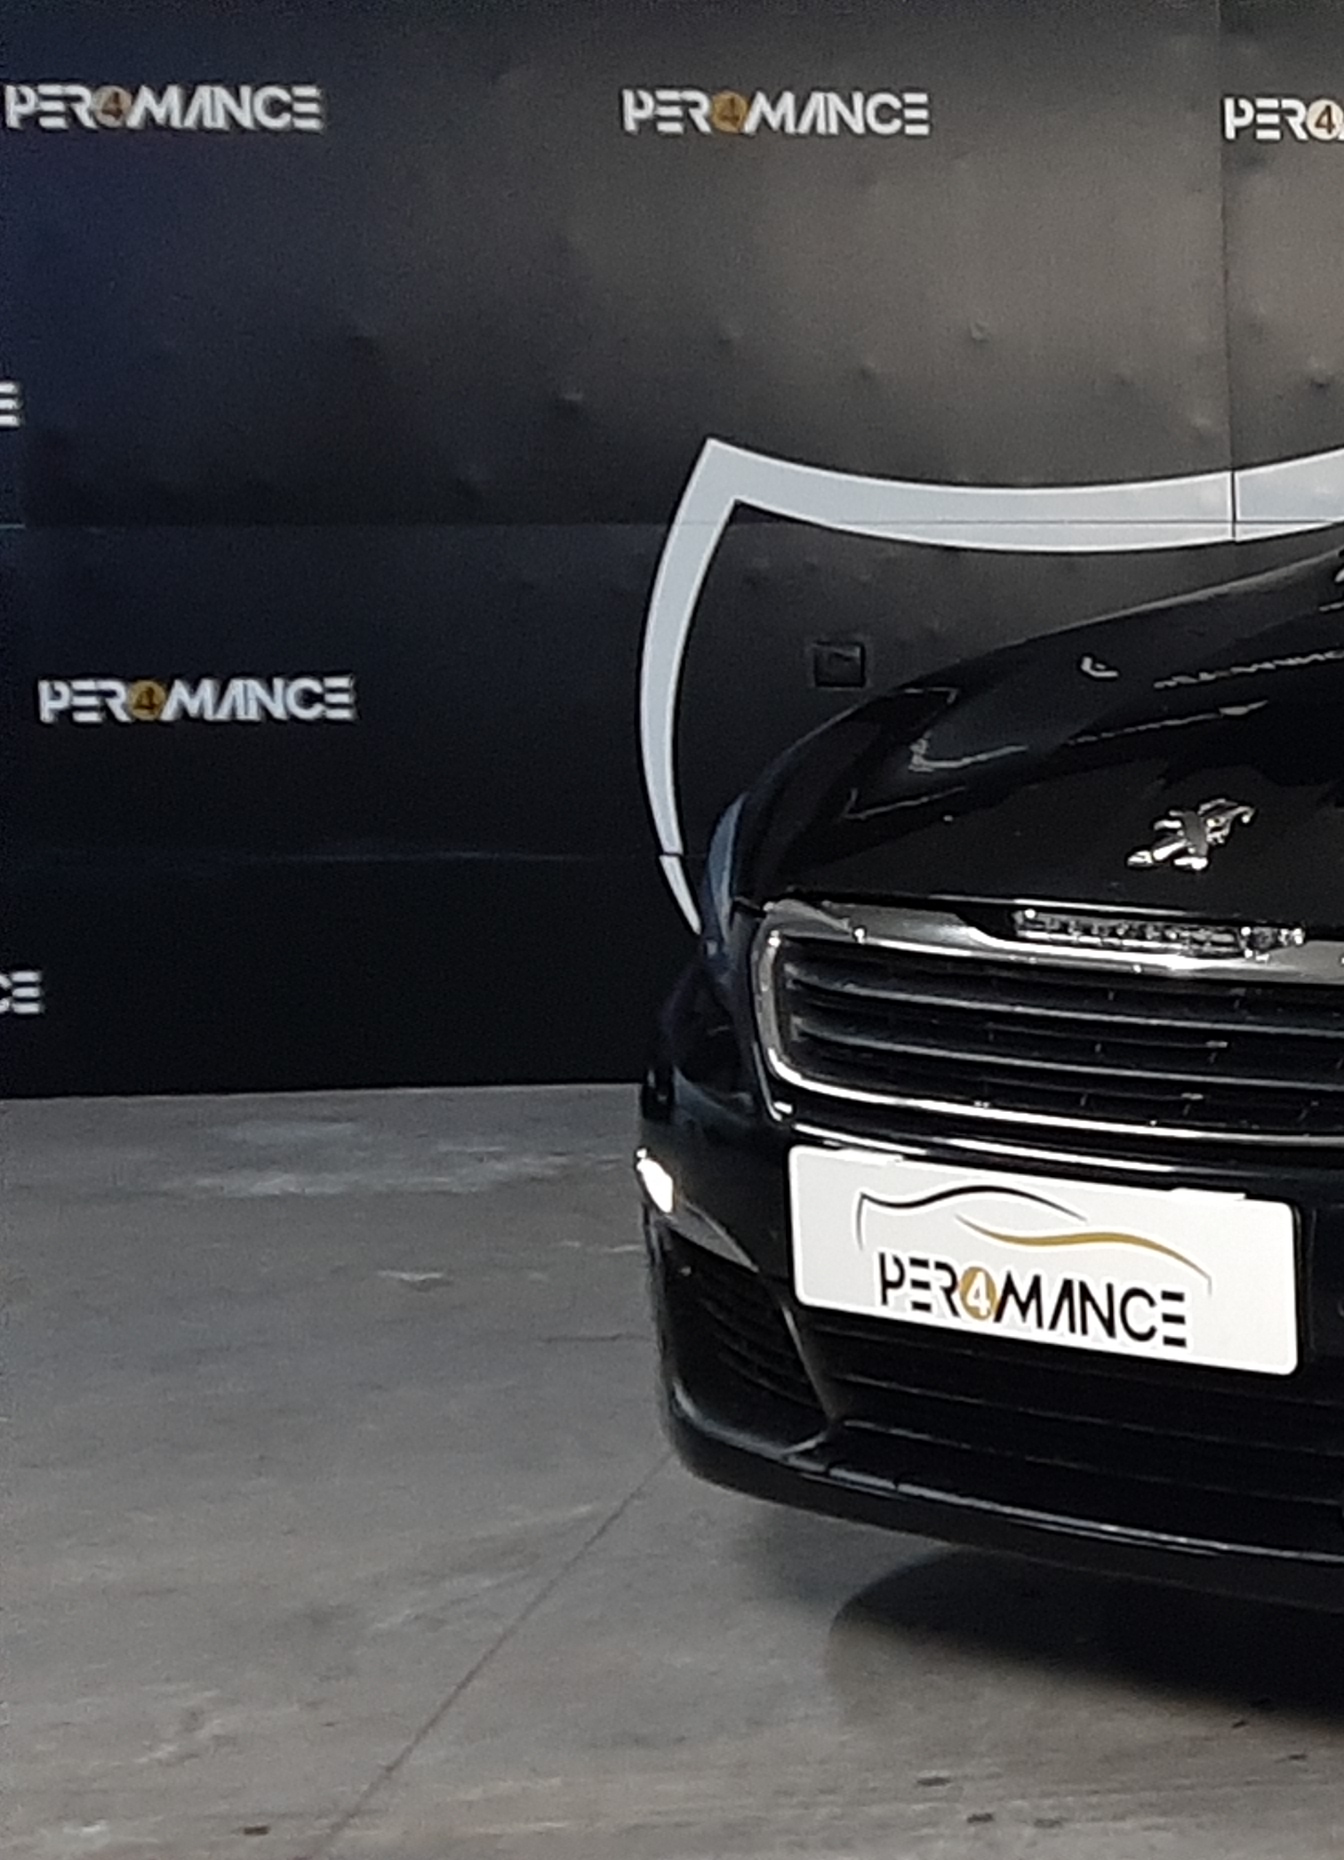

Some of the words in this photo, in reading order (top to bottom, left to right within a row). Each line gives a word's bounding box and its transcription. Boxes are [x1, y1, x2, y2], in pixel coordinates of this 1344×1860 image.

[5, 84, 322, 130] PER4MANCE
[623, 89, 930, 135] PER4MANCE
[39, 677, 355, 723] PER4MANCE
[878, 1252, 1188, 1348] PER4MANCE
